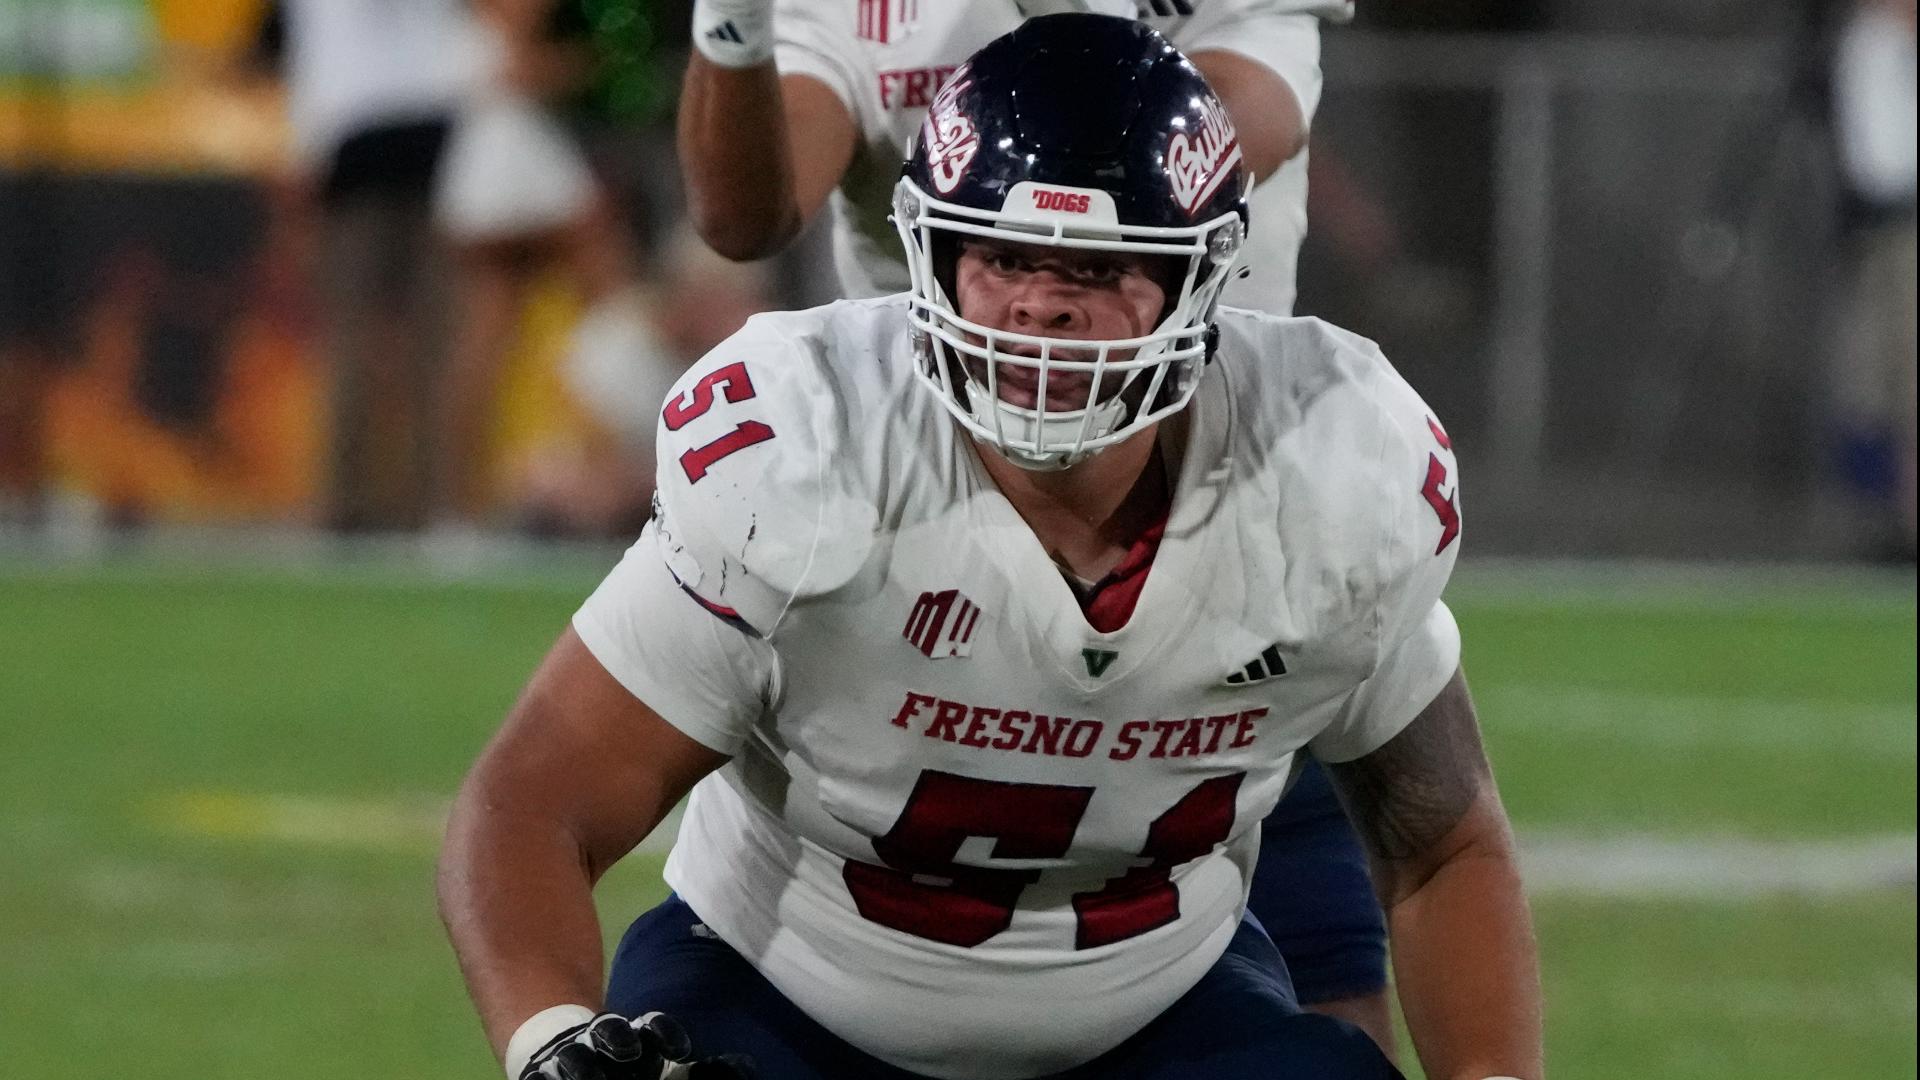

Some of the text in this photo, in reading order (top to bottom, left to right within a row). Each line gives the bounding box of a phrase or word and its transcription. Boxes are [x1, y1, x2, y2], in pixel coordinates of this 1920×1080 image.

[1032, 185, 1090, 214] 'DOGS
[662, 361, 776, 485] 51
[1082, 648, 1119, 678] V
[891, 691, 1269, 761] FRESNO STATE
[842, 768, 1247, 951] 51
